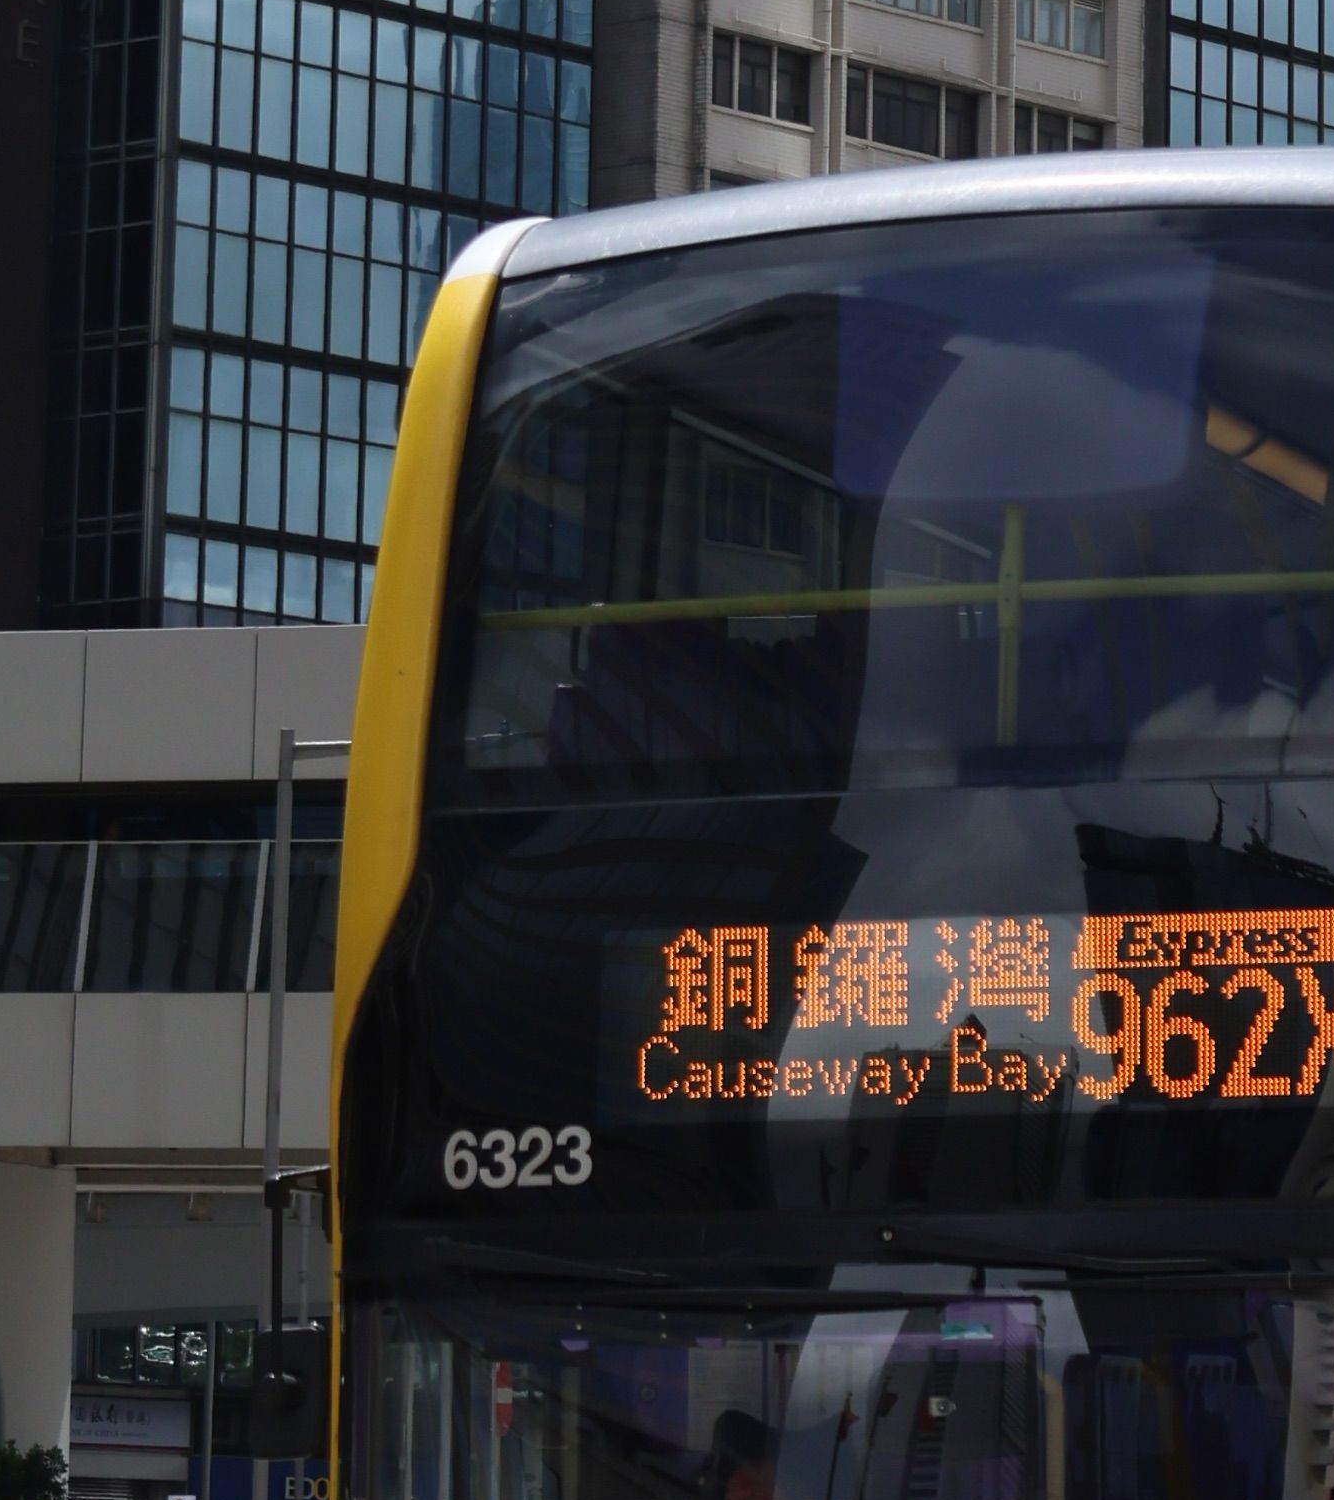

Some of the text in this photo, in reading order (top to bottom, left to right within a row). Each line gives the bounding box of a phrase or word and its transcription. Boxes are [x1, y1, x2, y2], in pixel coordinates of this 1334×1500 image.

[661, 915, 1051, 1033] 銅鑼灣
[1115, 917, 1319, 966] Express
[637, 1027, 1067, 1105] Causeway Bay
[443, 1124, 593, 1190] 6323
